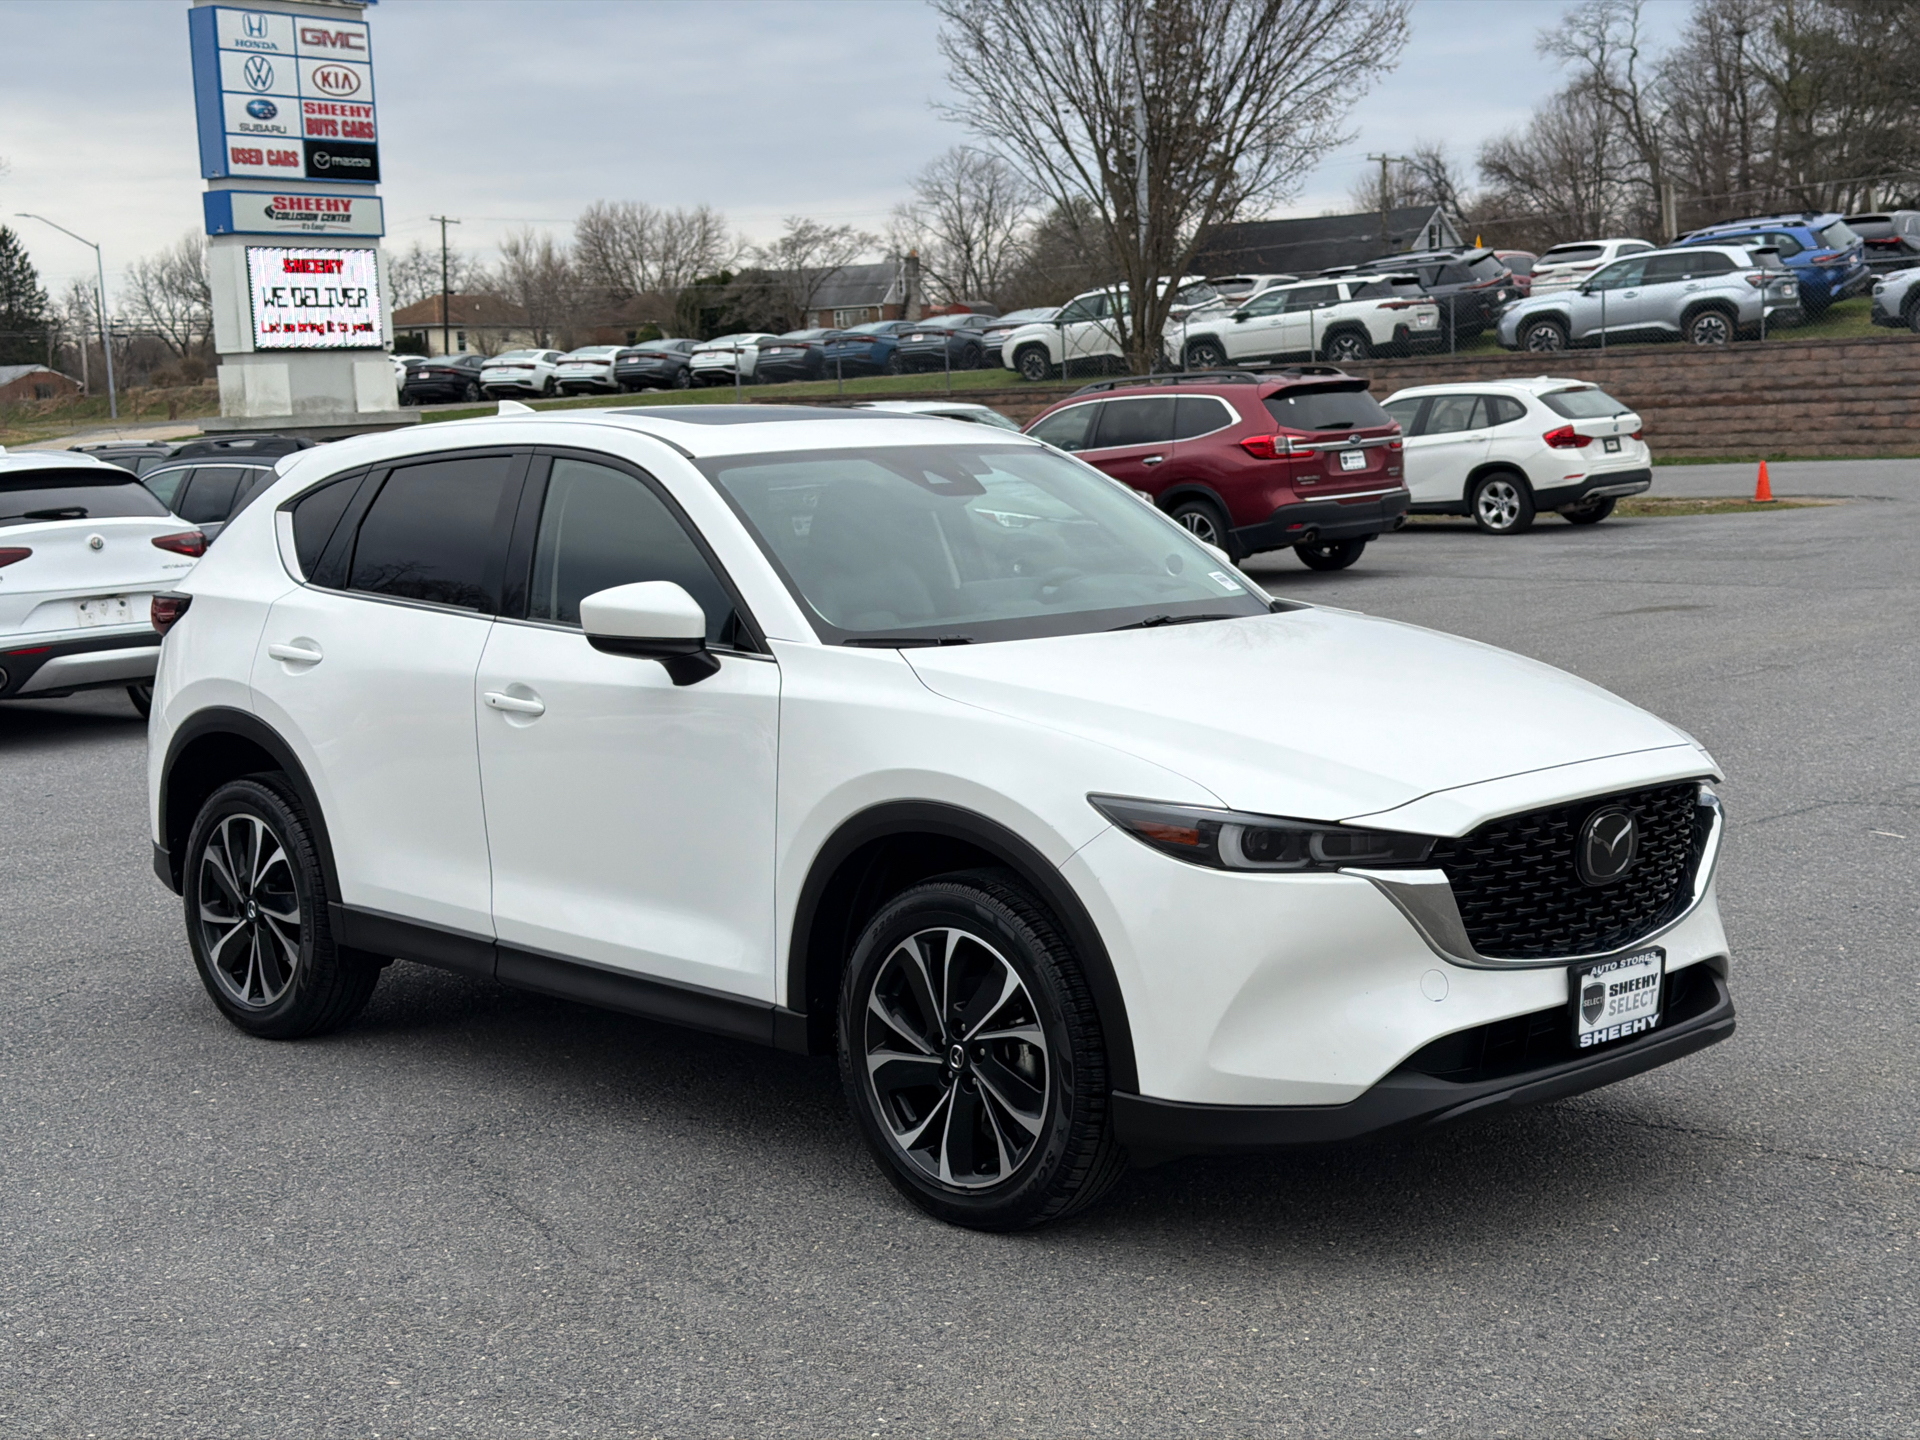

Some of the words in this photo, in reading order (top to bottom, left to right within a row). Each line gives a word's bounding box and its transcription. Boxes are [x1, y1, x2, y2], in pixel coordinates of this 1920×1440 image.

[235, 39, 278, 51] HONDA
[301, 28, 365, 51] GMC
[321, 71, 353, 90] KIA
[304, 102, 372, 118] SHEEHY
[239, 122, 286, 134] SUBARU
[306, 118, 337, 136] BUYS
[342, 120, 374, 139] CARS
[231, 147, 262, 165] USED
[267, 150, 299, 167] CARS
[331, 157, 371, 167] mazda
[273, 197, 352, 212] SHEEHY
[275, 212, 318, 222] COLLISION
[321, 213, 351, 223] CENTER
[283, 258, 343, 274] SHEEHY
[262, 287, 288, 308] WE
[290, 287, 368, 308] DELIVER
[1590, 962, 1617, 976] AUTO
[1620, 951, 1657, 968] STORES
[1609, 973, 1658, 997] SHEEHY
[1583, 996, 1605, 1008] SELECT
[1609, 989, 1657, 1017] SELECT
[1579, 1014, 1659, 1048] SHEEHY
